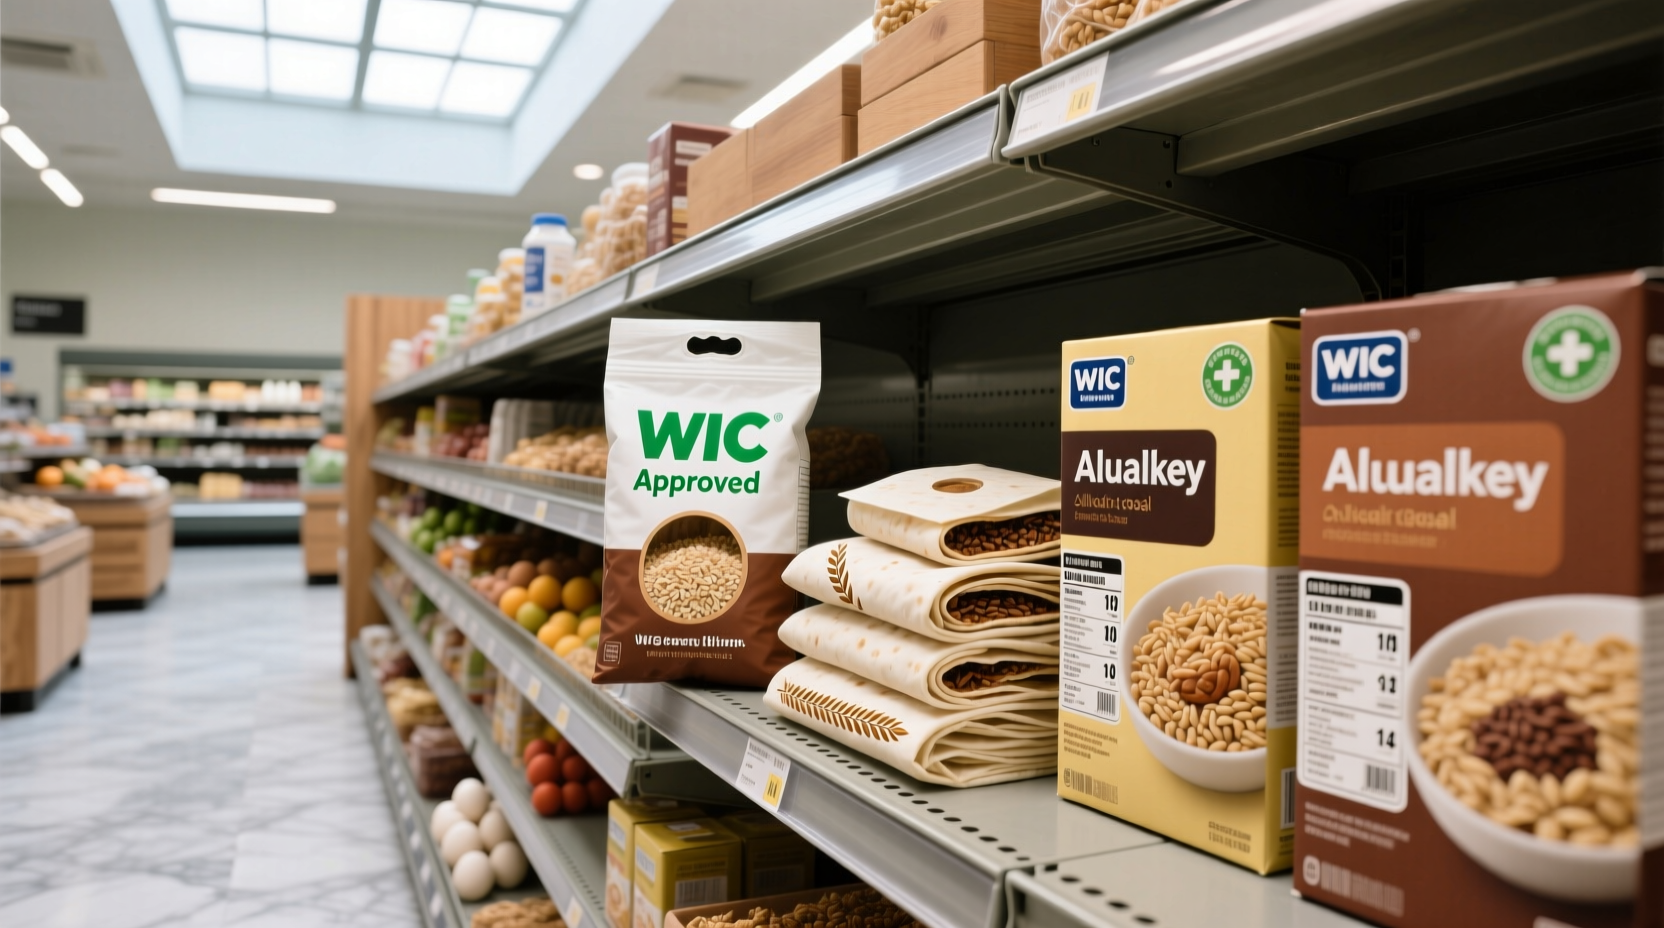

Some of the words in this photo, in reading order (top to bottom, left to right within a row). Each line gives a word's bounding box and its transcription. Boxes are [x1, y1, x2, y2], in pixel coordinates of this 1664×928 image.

[1320, 343, 1396, 380] WIC
[1074, 365, 1121, 391] WIC
[638, 409, 770, 463] WIC
[633, 468, 761, 497] Approved
[1074, 449, 1207, 496] Alualkey
[1104, 625, 1117, 643] 10
[1103, 663, 1116, 680] 10
[1378, 729, 1396, 748] 14
